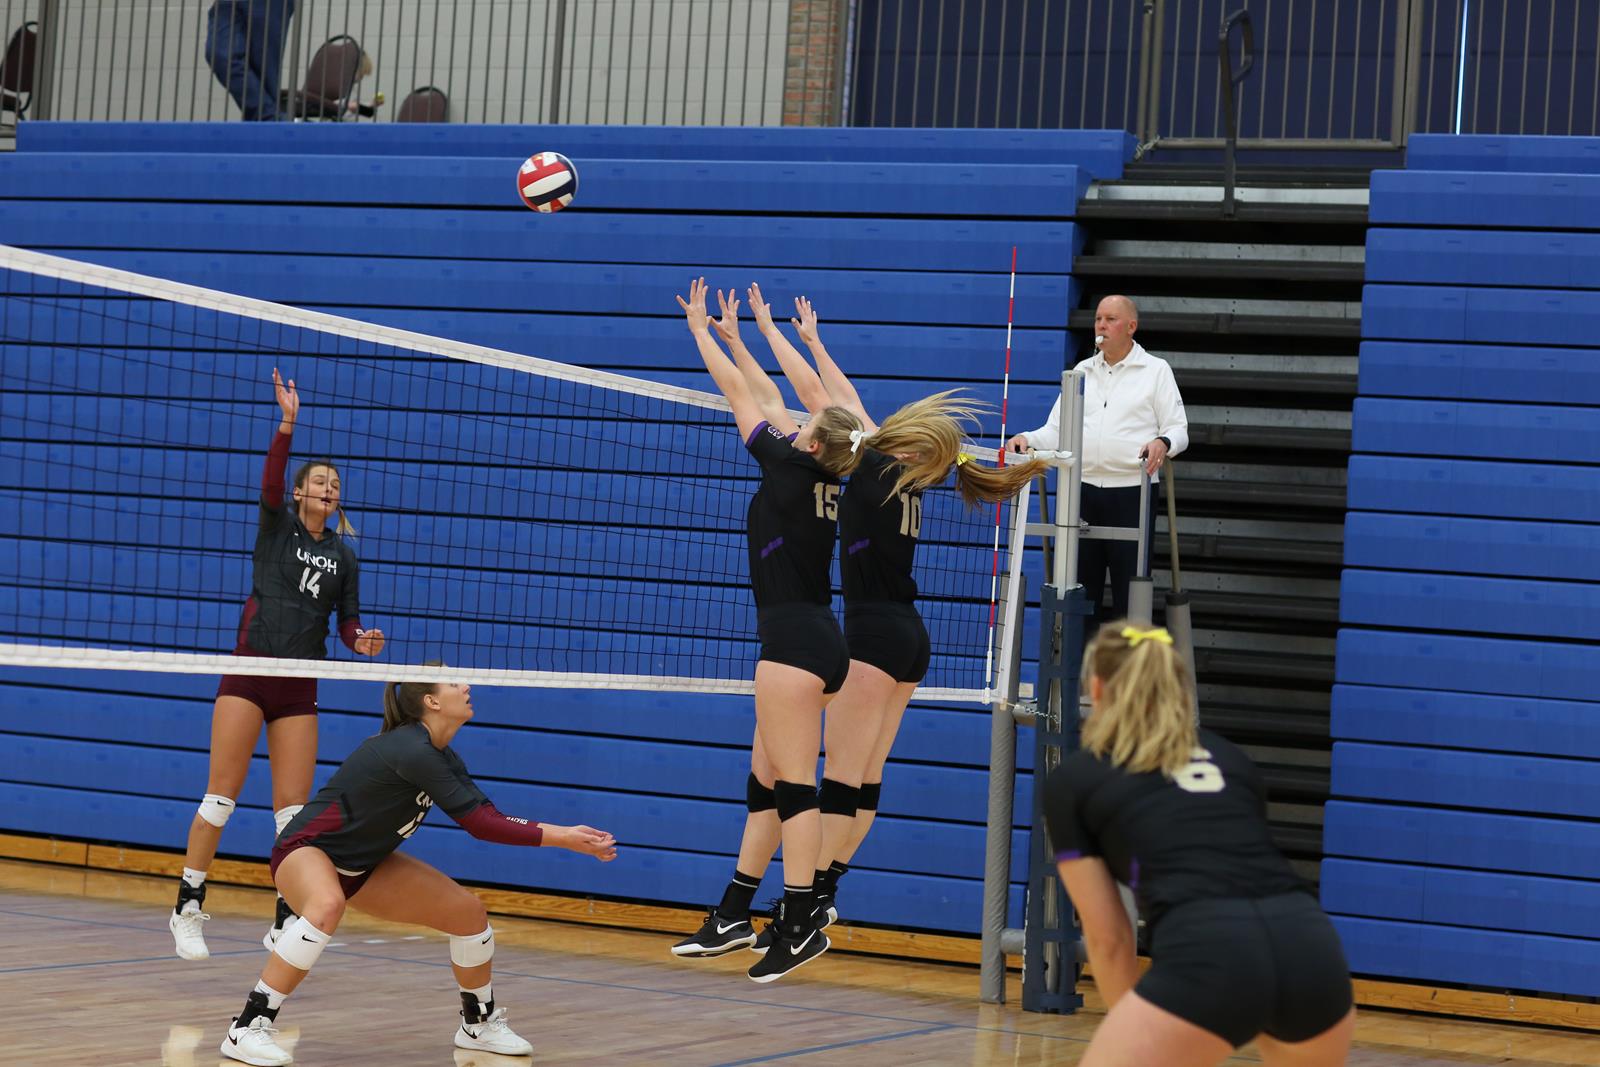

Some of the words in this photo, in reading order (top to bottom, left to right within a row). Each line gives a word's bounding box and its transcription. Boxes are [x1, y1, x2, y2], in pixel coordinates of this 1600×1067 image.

[813, 481, 840, 521] 15
[900, 492, 921, 538] 10
[296, 547, 337, 575] UNOH
[299, 566, 322, 599] 14
[1174, 748, 1226, 793] 6
